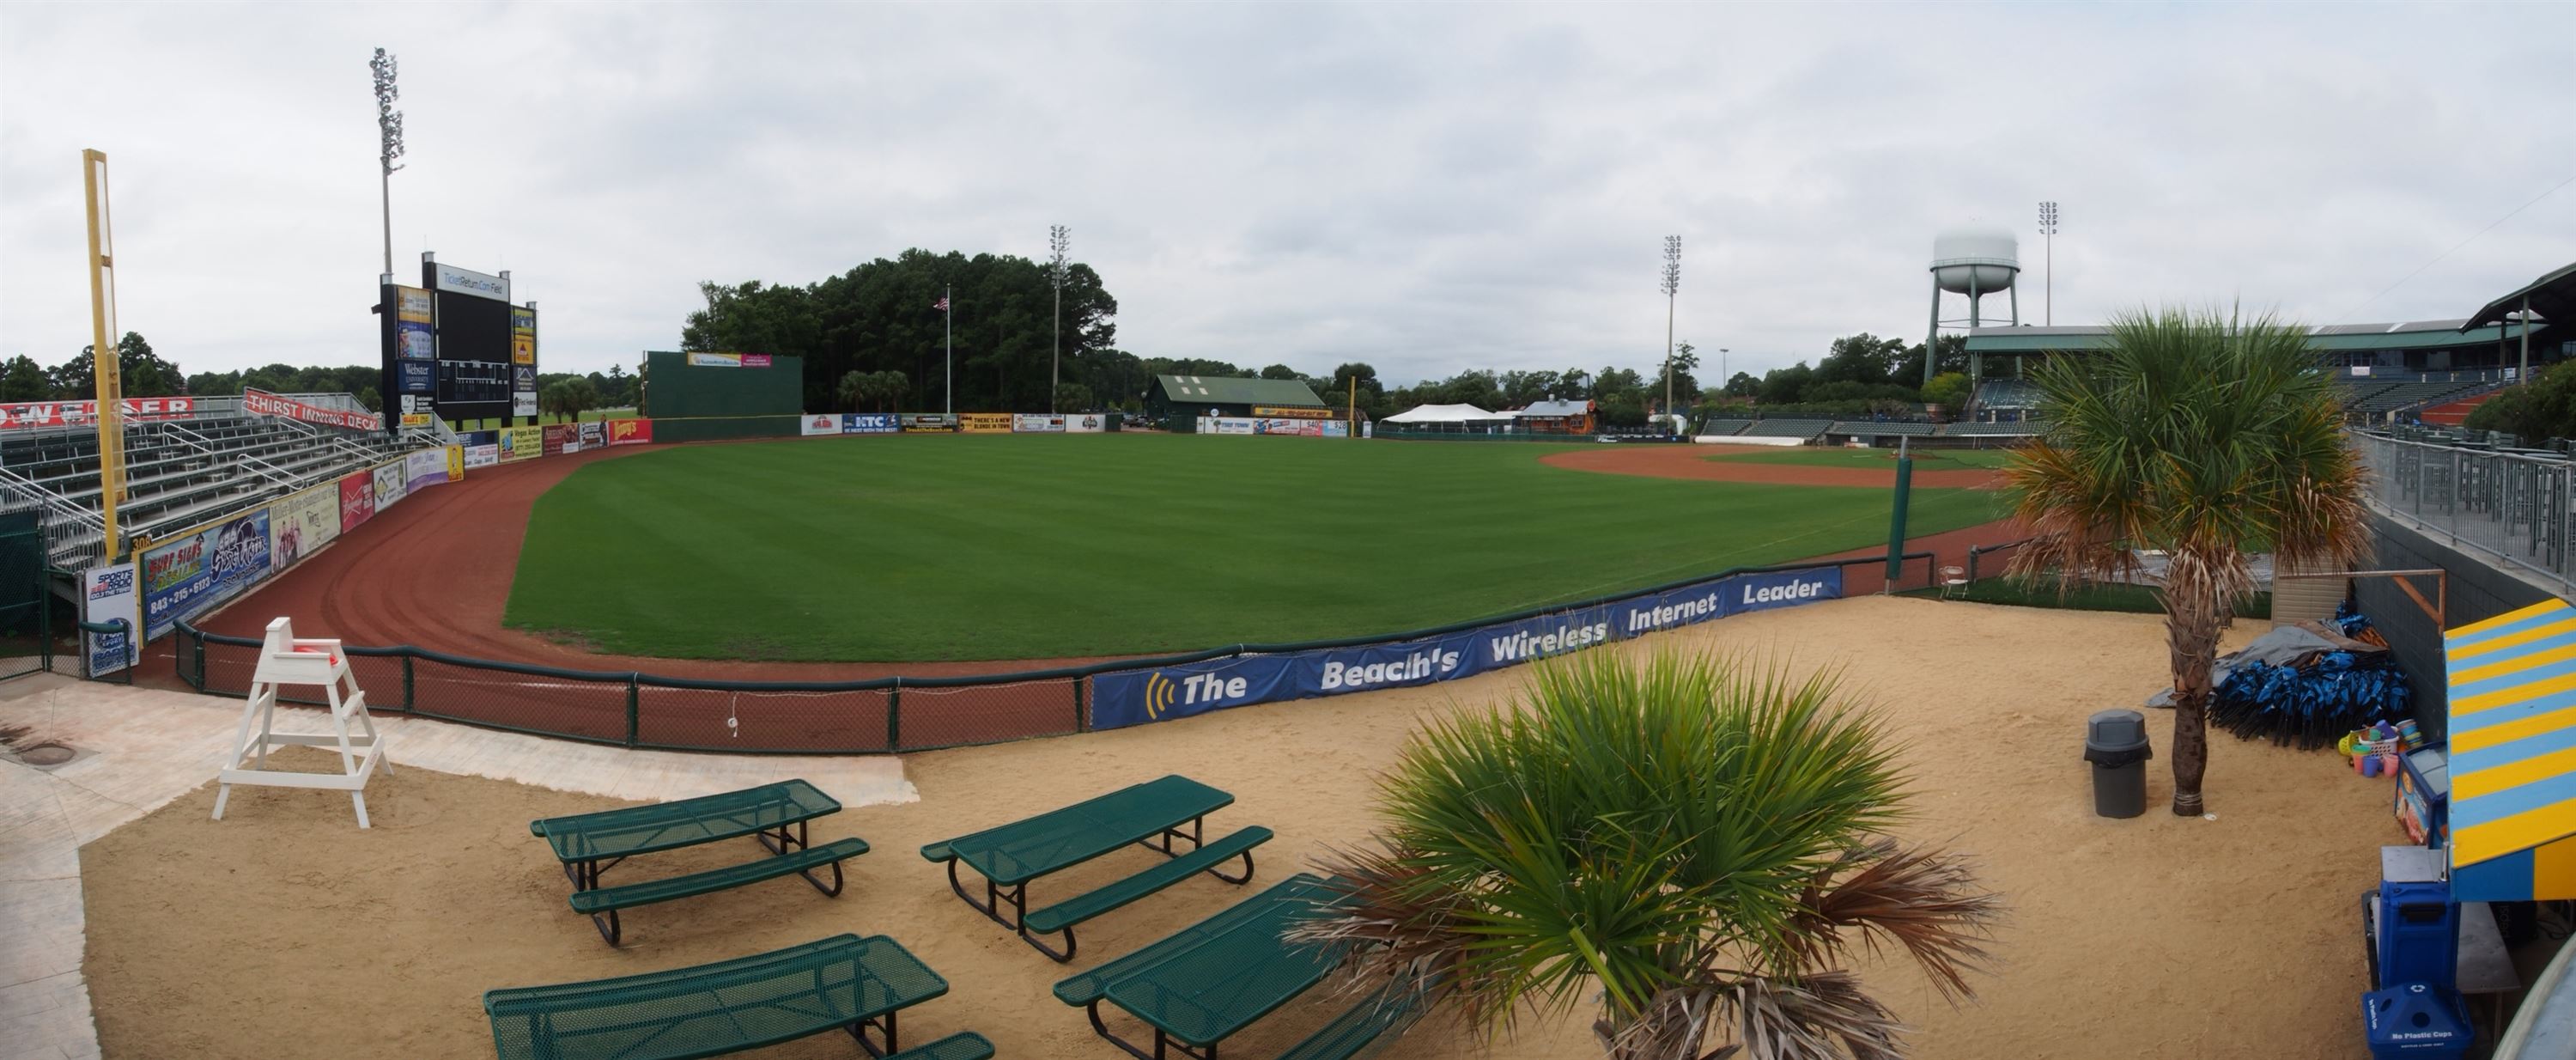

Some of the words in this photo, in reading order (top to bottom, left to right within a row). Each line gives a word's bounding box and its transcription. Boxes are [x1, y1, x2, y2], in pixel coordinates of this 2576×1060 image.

[405, 362, 429, 375] Webster
[250, 395, 298, 417] THIRST
[302, 407, 345, 426] INNING
[348, 416, 380, 430] DECK
[514, 429, 527, 438] Vegas
[133, 536, 151, 551] 308
[147, 551, 175, 582] SURF
[177, 542, 203, 564] SIGNS
[98, 569, 134, 584] SPORTS
[107, 576, 133, 592] RADIO
[150, 598, 168, 614] 843
[173, 588, 189, 603] 215
[193, 576, 210, 594] 6123
[1183, 672, 1248, 705] The
[1492, 622, 1608, 662] Wireless
[1629, 592, 1718, 632] Internet
[1743, 579, 1823, 605] Leader
